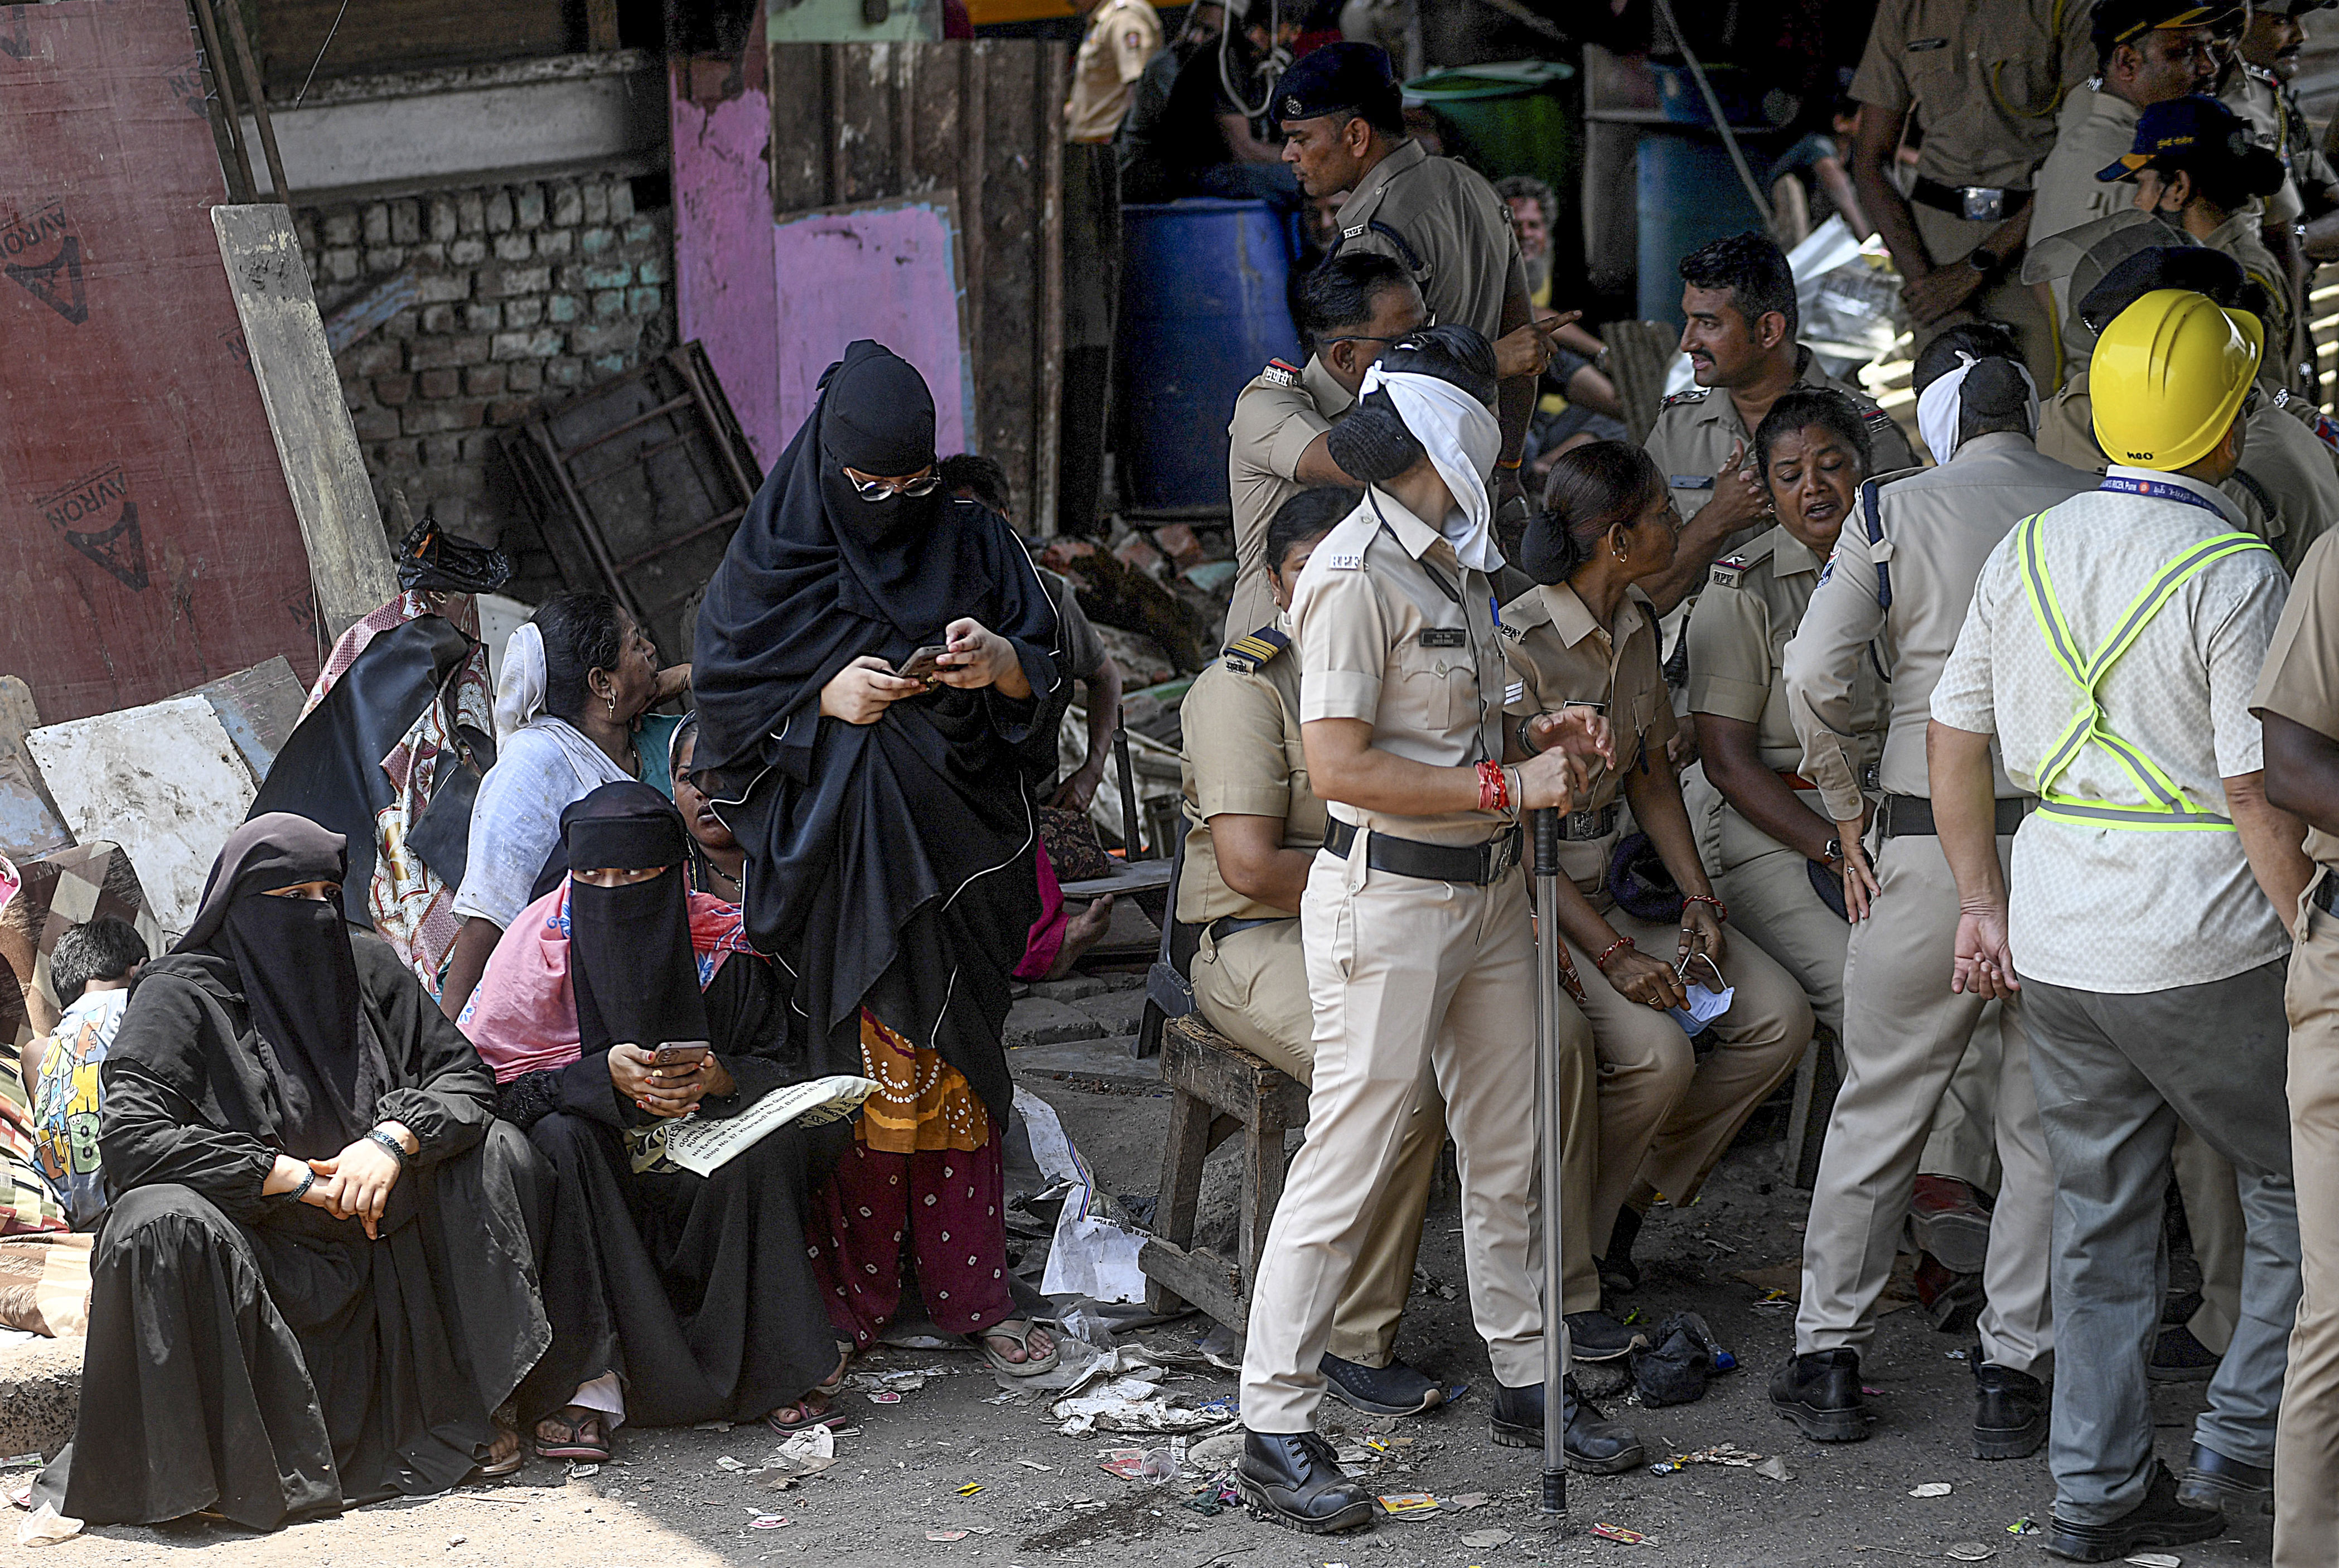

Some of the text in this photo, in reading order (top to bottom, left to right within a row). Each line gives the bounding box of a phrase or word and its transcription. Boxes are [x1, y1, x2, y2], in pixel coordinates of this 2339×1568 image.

[1344, 224, 1364, 239] RPF
[45, 472, 127, 531] AVRON
[1330, 554, 1361, 569] RPF
[669, 1124, 687, 1150] DRESS
[687, 1127, 716, 1148] PUNJABI,
[699, 1130, 727, 1149] Exchange
[739, 1110, 760, 1122] Refund
[703, 1147, 720, 1160] Shop
[785, 1091, 808, 1106] Bandra
